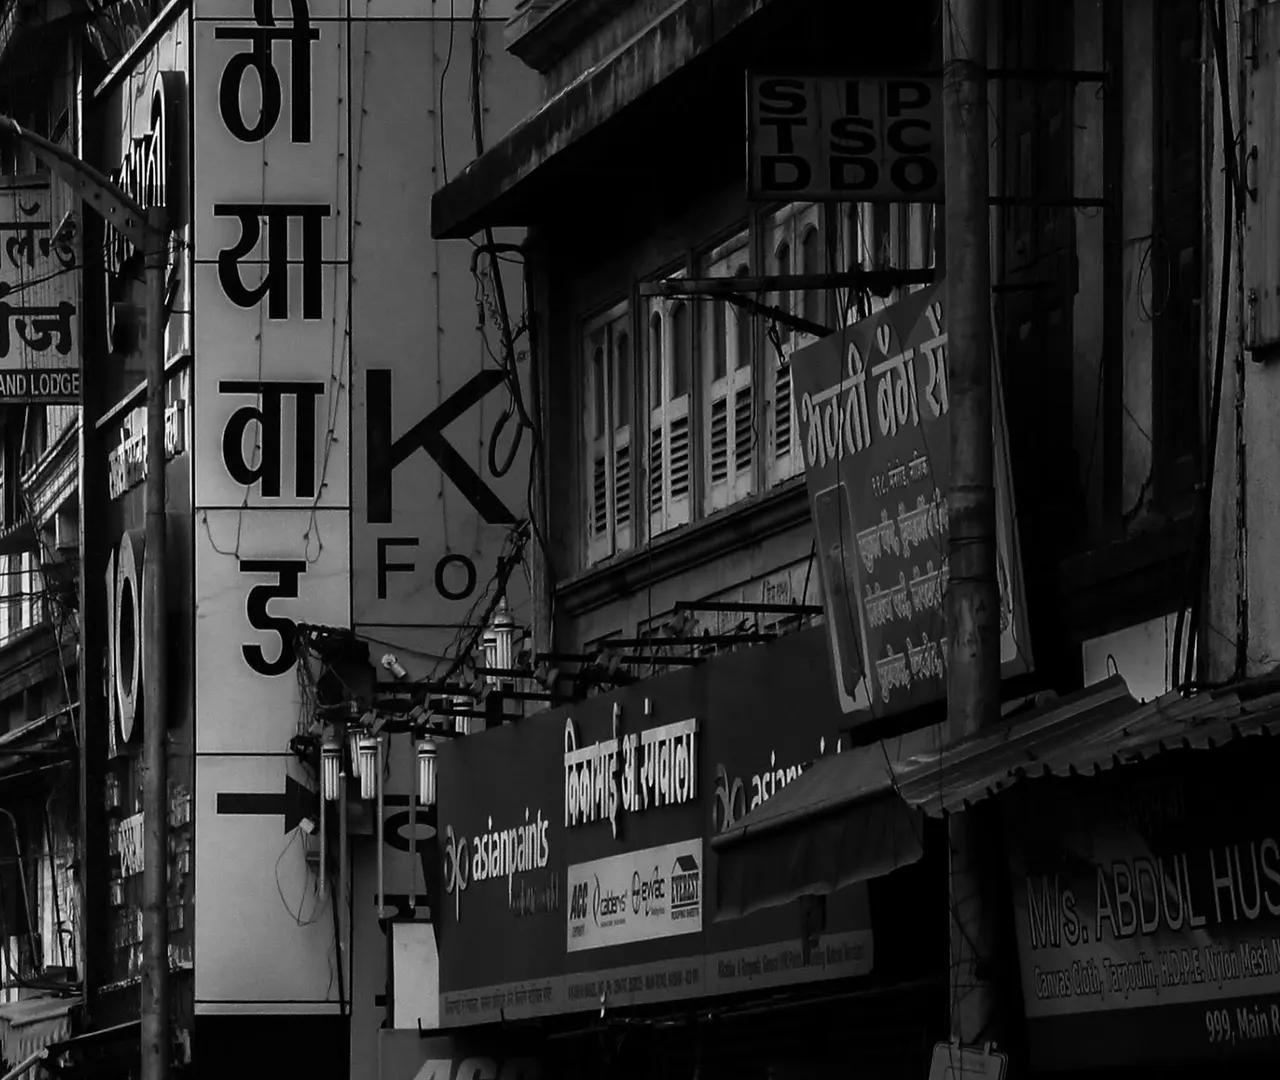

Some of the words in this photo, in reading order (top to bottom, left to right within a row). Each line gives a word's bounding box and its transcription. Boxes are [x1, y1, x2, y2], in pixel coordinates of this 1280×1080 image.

[472, 806, 550, 908] asianpaints
[1095, 852, 1207, 942] ABDUL
[1034, 964, 1071, 1000] Canvas
[1204, 943, 1239, 991] Nylon
[1236, 1003, 1270, 1042] Main
